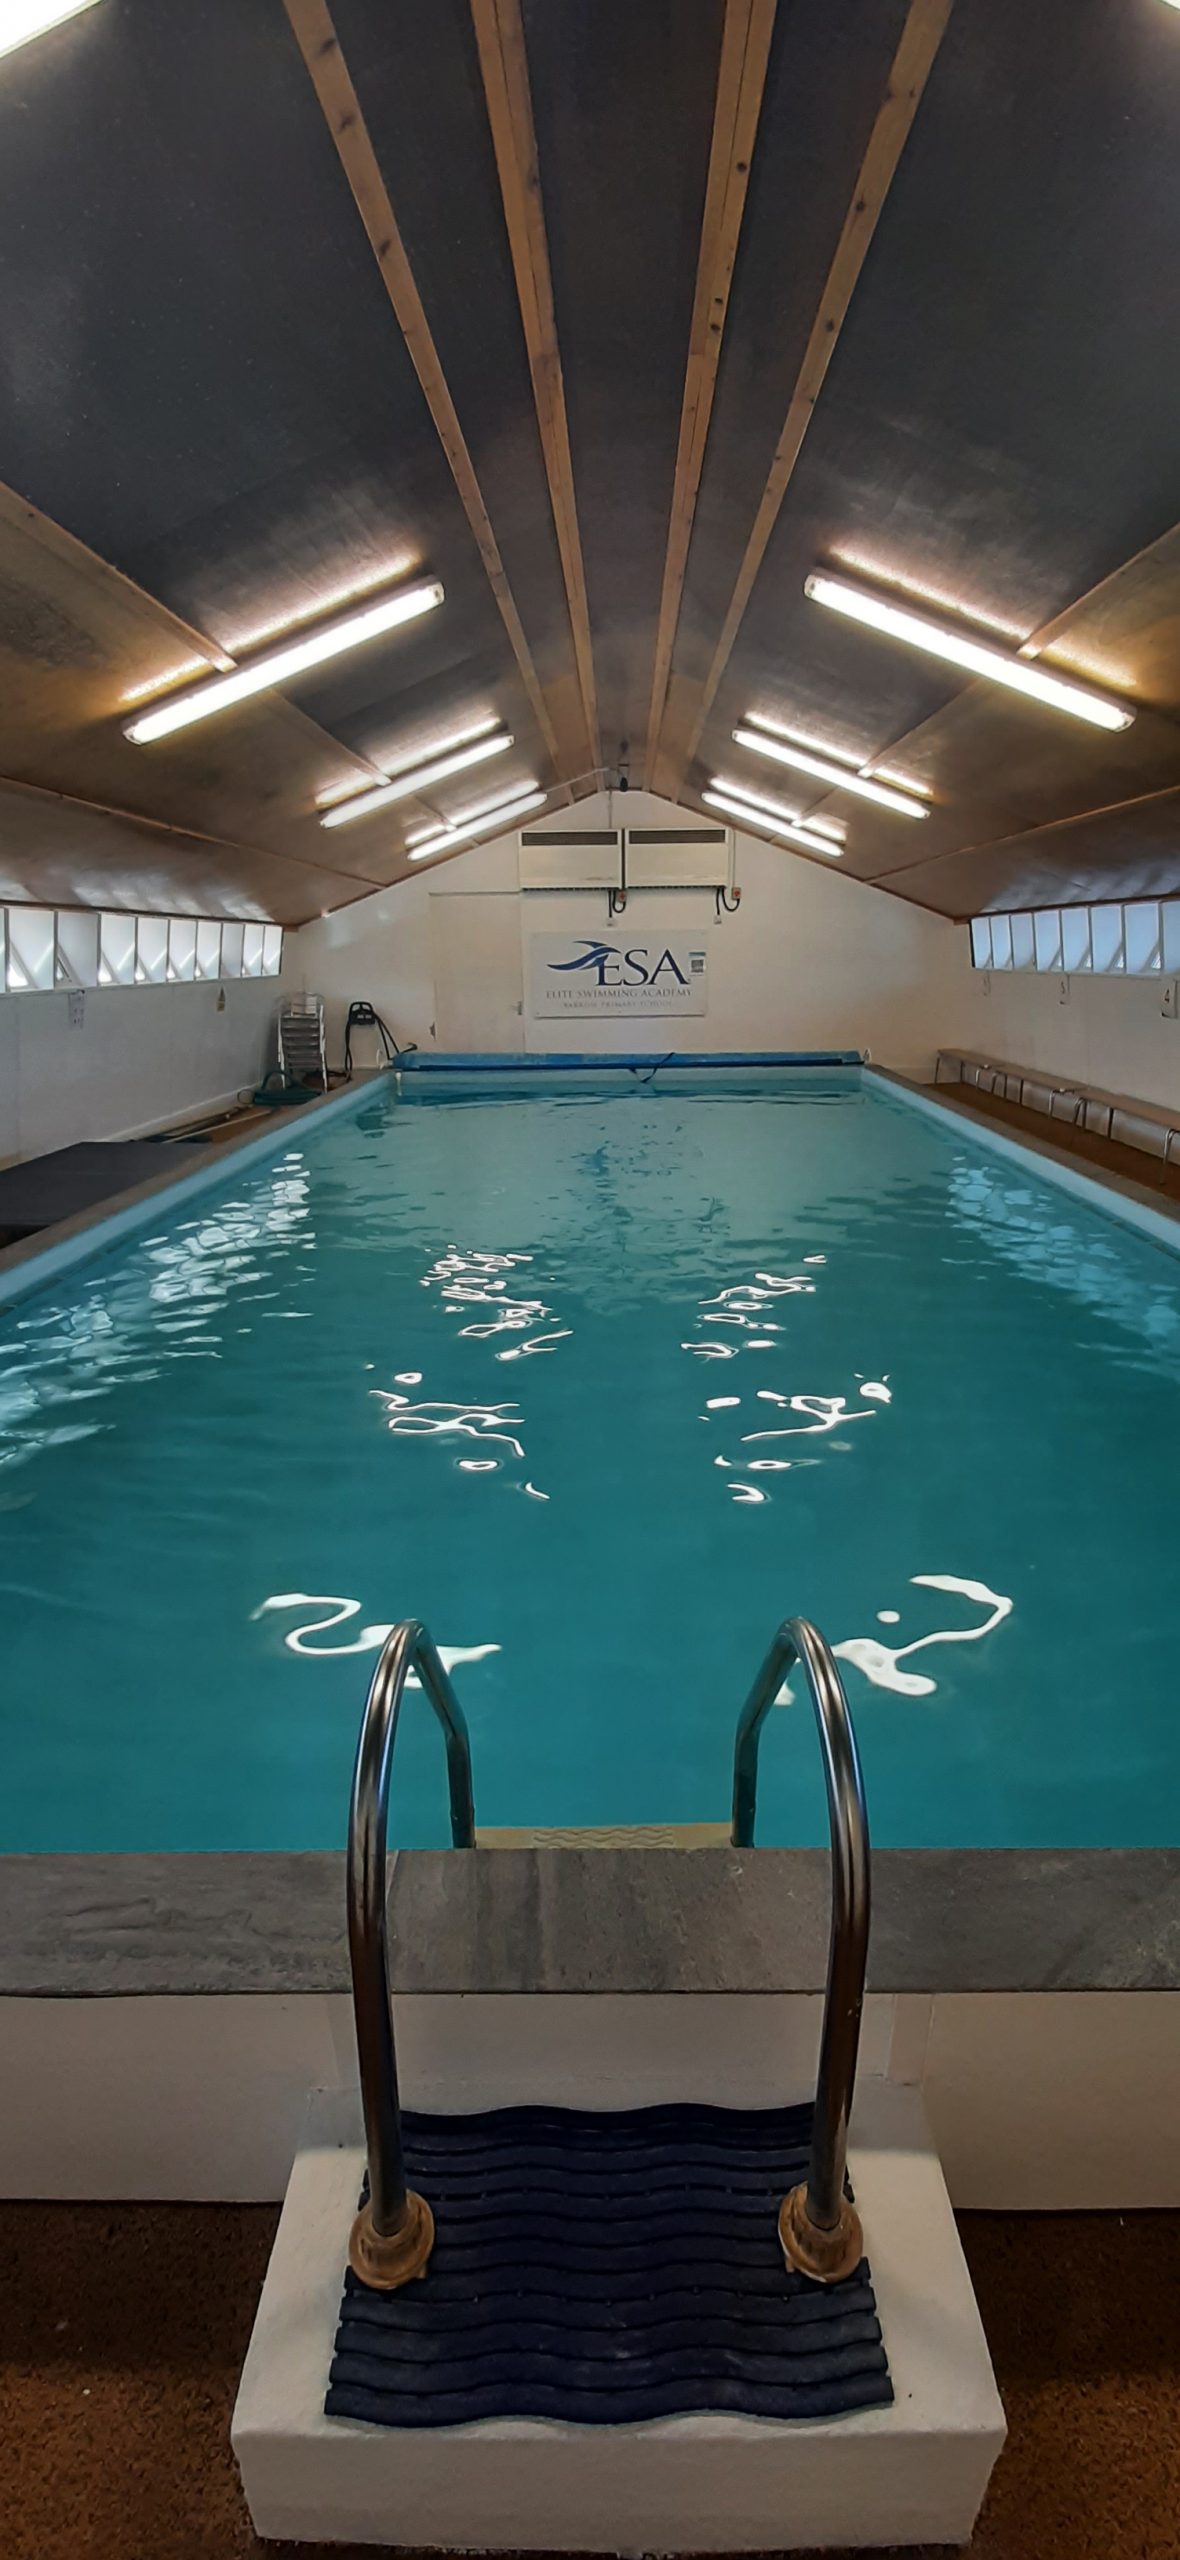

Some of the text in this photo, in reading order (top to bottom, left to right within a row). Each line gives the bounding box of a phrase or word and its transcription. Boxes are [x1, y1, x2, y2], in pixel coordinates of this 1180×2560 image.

[595, 948, 691, 987] ESA
[545, 987, 692, 1000] ELITE SWIMMING ACADEMY
